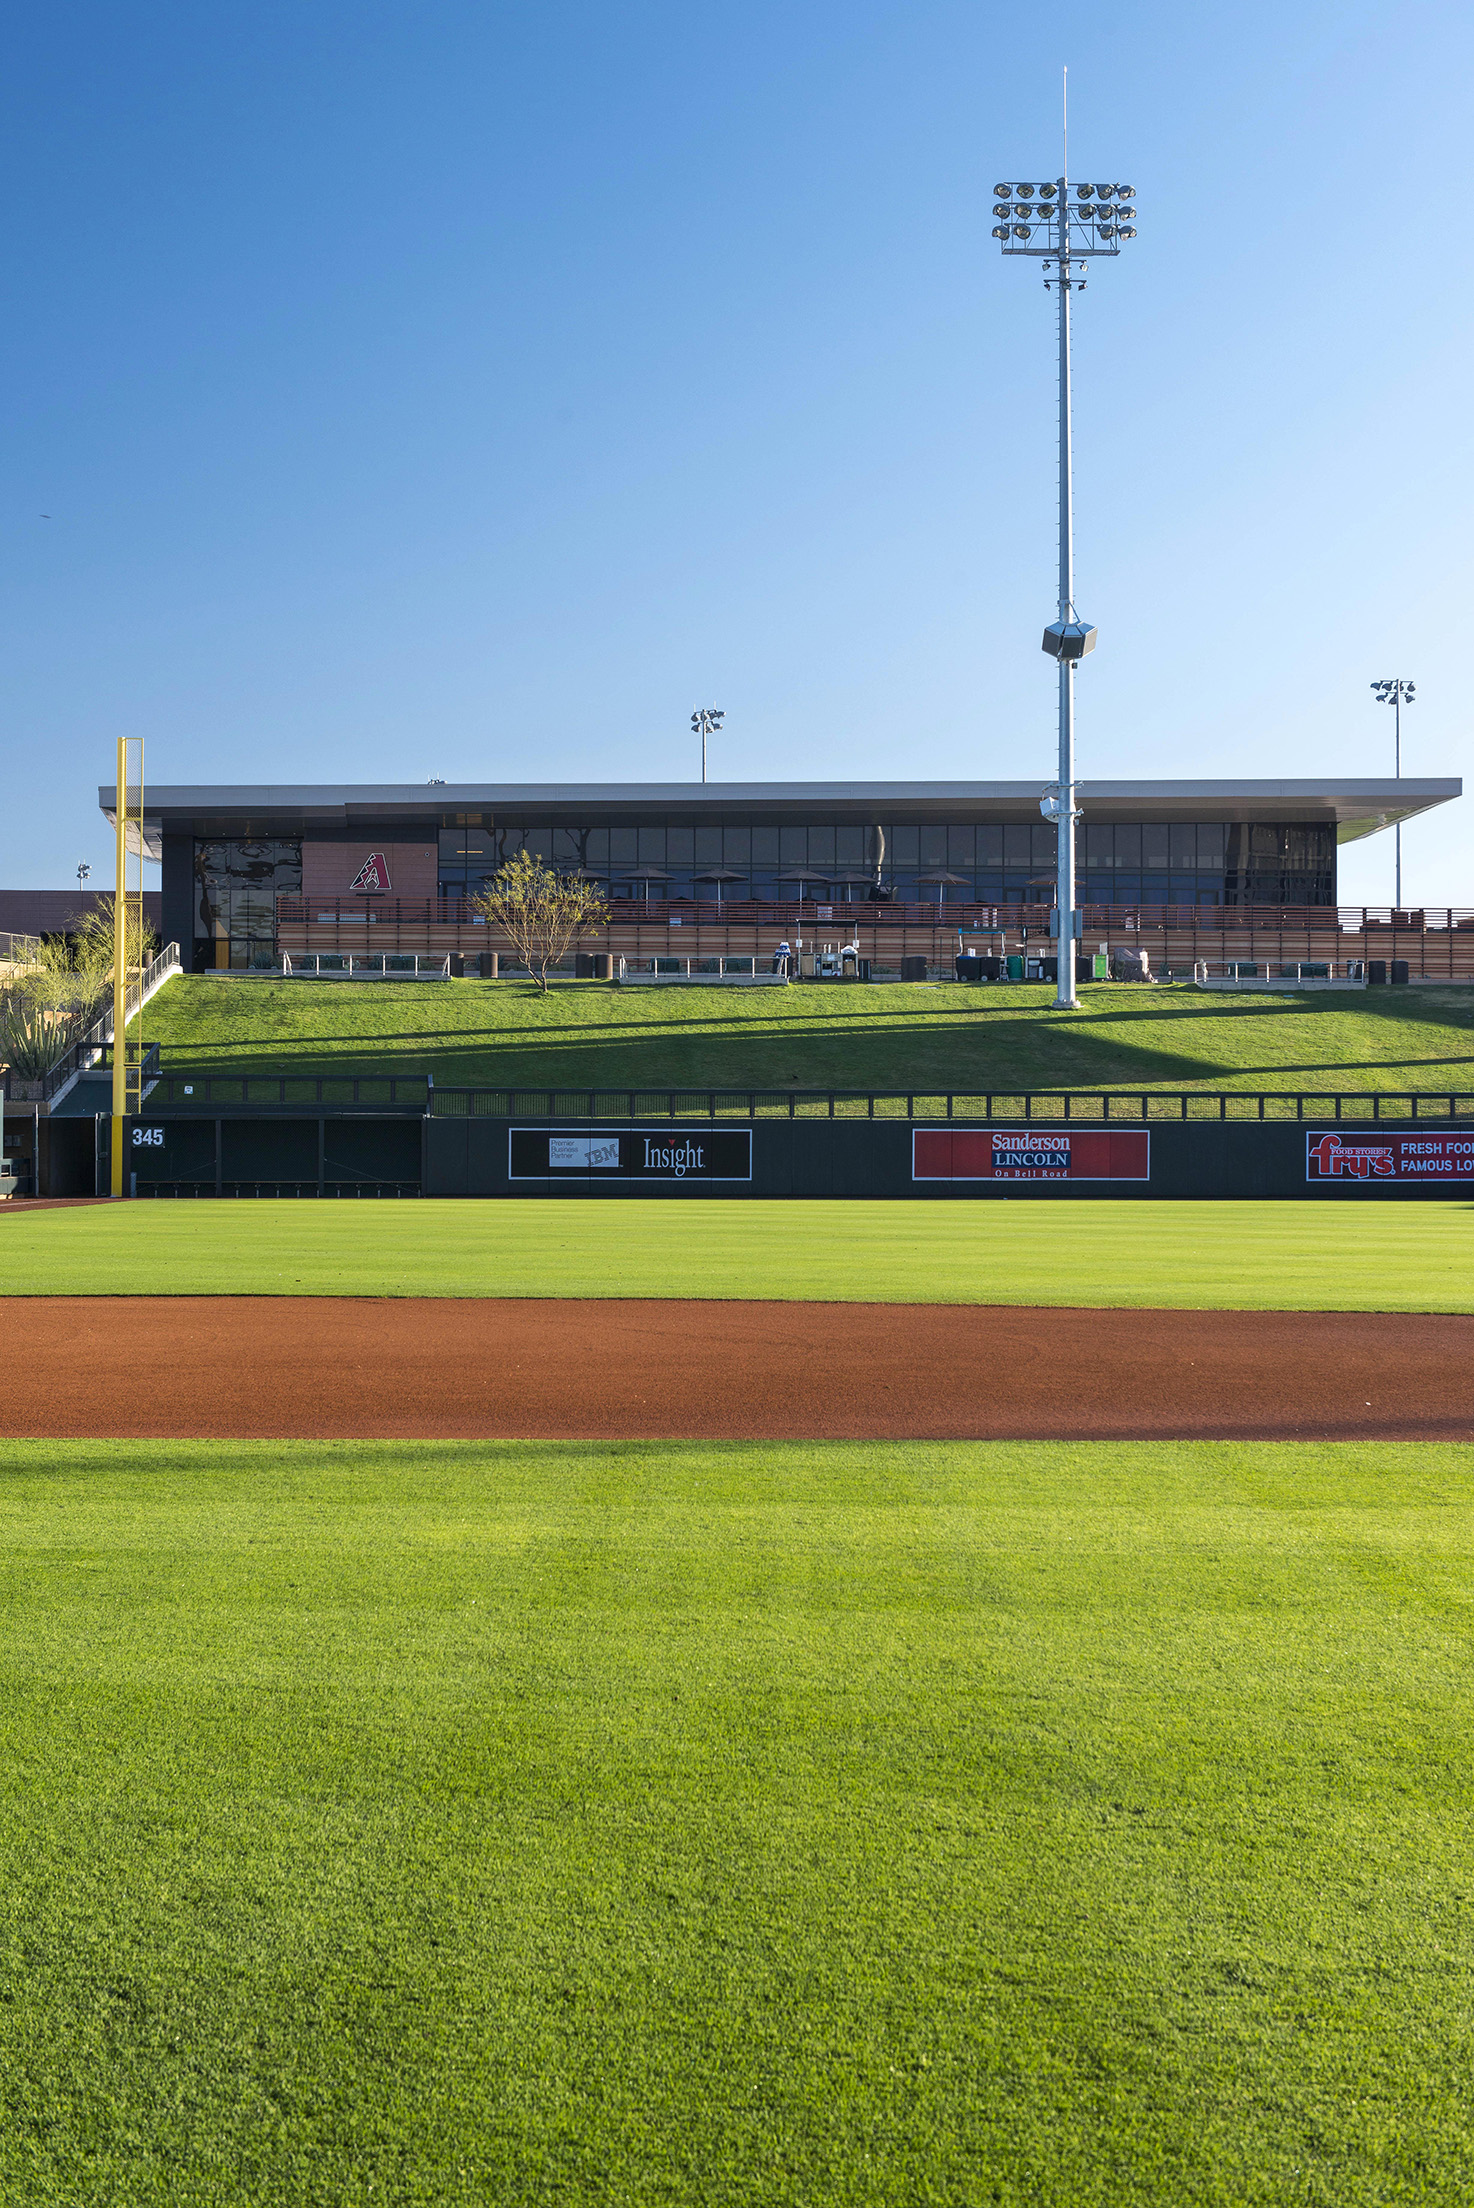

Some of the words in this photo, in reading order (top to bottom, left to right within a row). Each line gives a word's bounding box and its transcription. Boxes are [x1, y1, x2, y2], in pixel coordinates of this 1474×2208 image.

[132, 1128, 163, 1145] 345
[992, 1133, 1070, 1150] Sanderson
[584, 1143, 619, 1167] IBM
[643, 1138, 704, 1177] Insight
[1309, 1134, 1394, 1179] fry's
[1401, 1143, 1442, 1155] FRESH
[995, 1153, 1068, 1165] LINCOLN
[1401, 1160, 1453, 1172] FAMOUS
[995, 1170, 1009, 1178] On
[1015, 1170, 1036, 1178] Bell
[1042, 1170, 1068, 1178] Road
